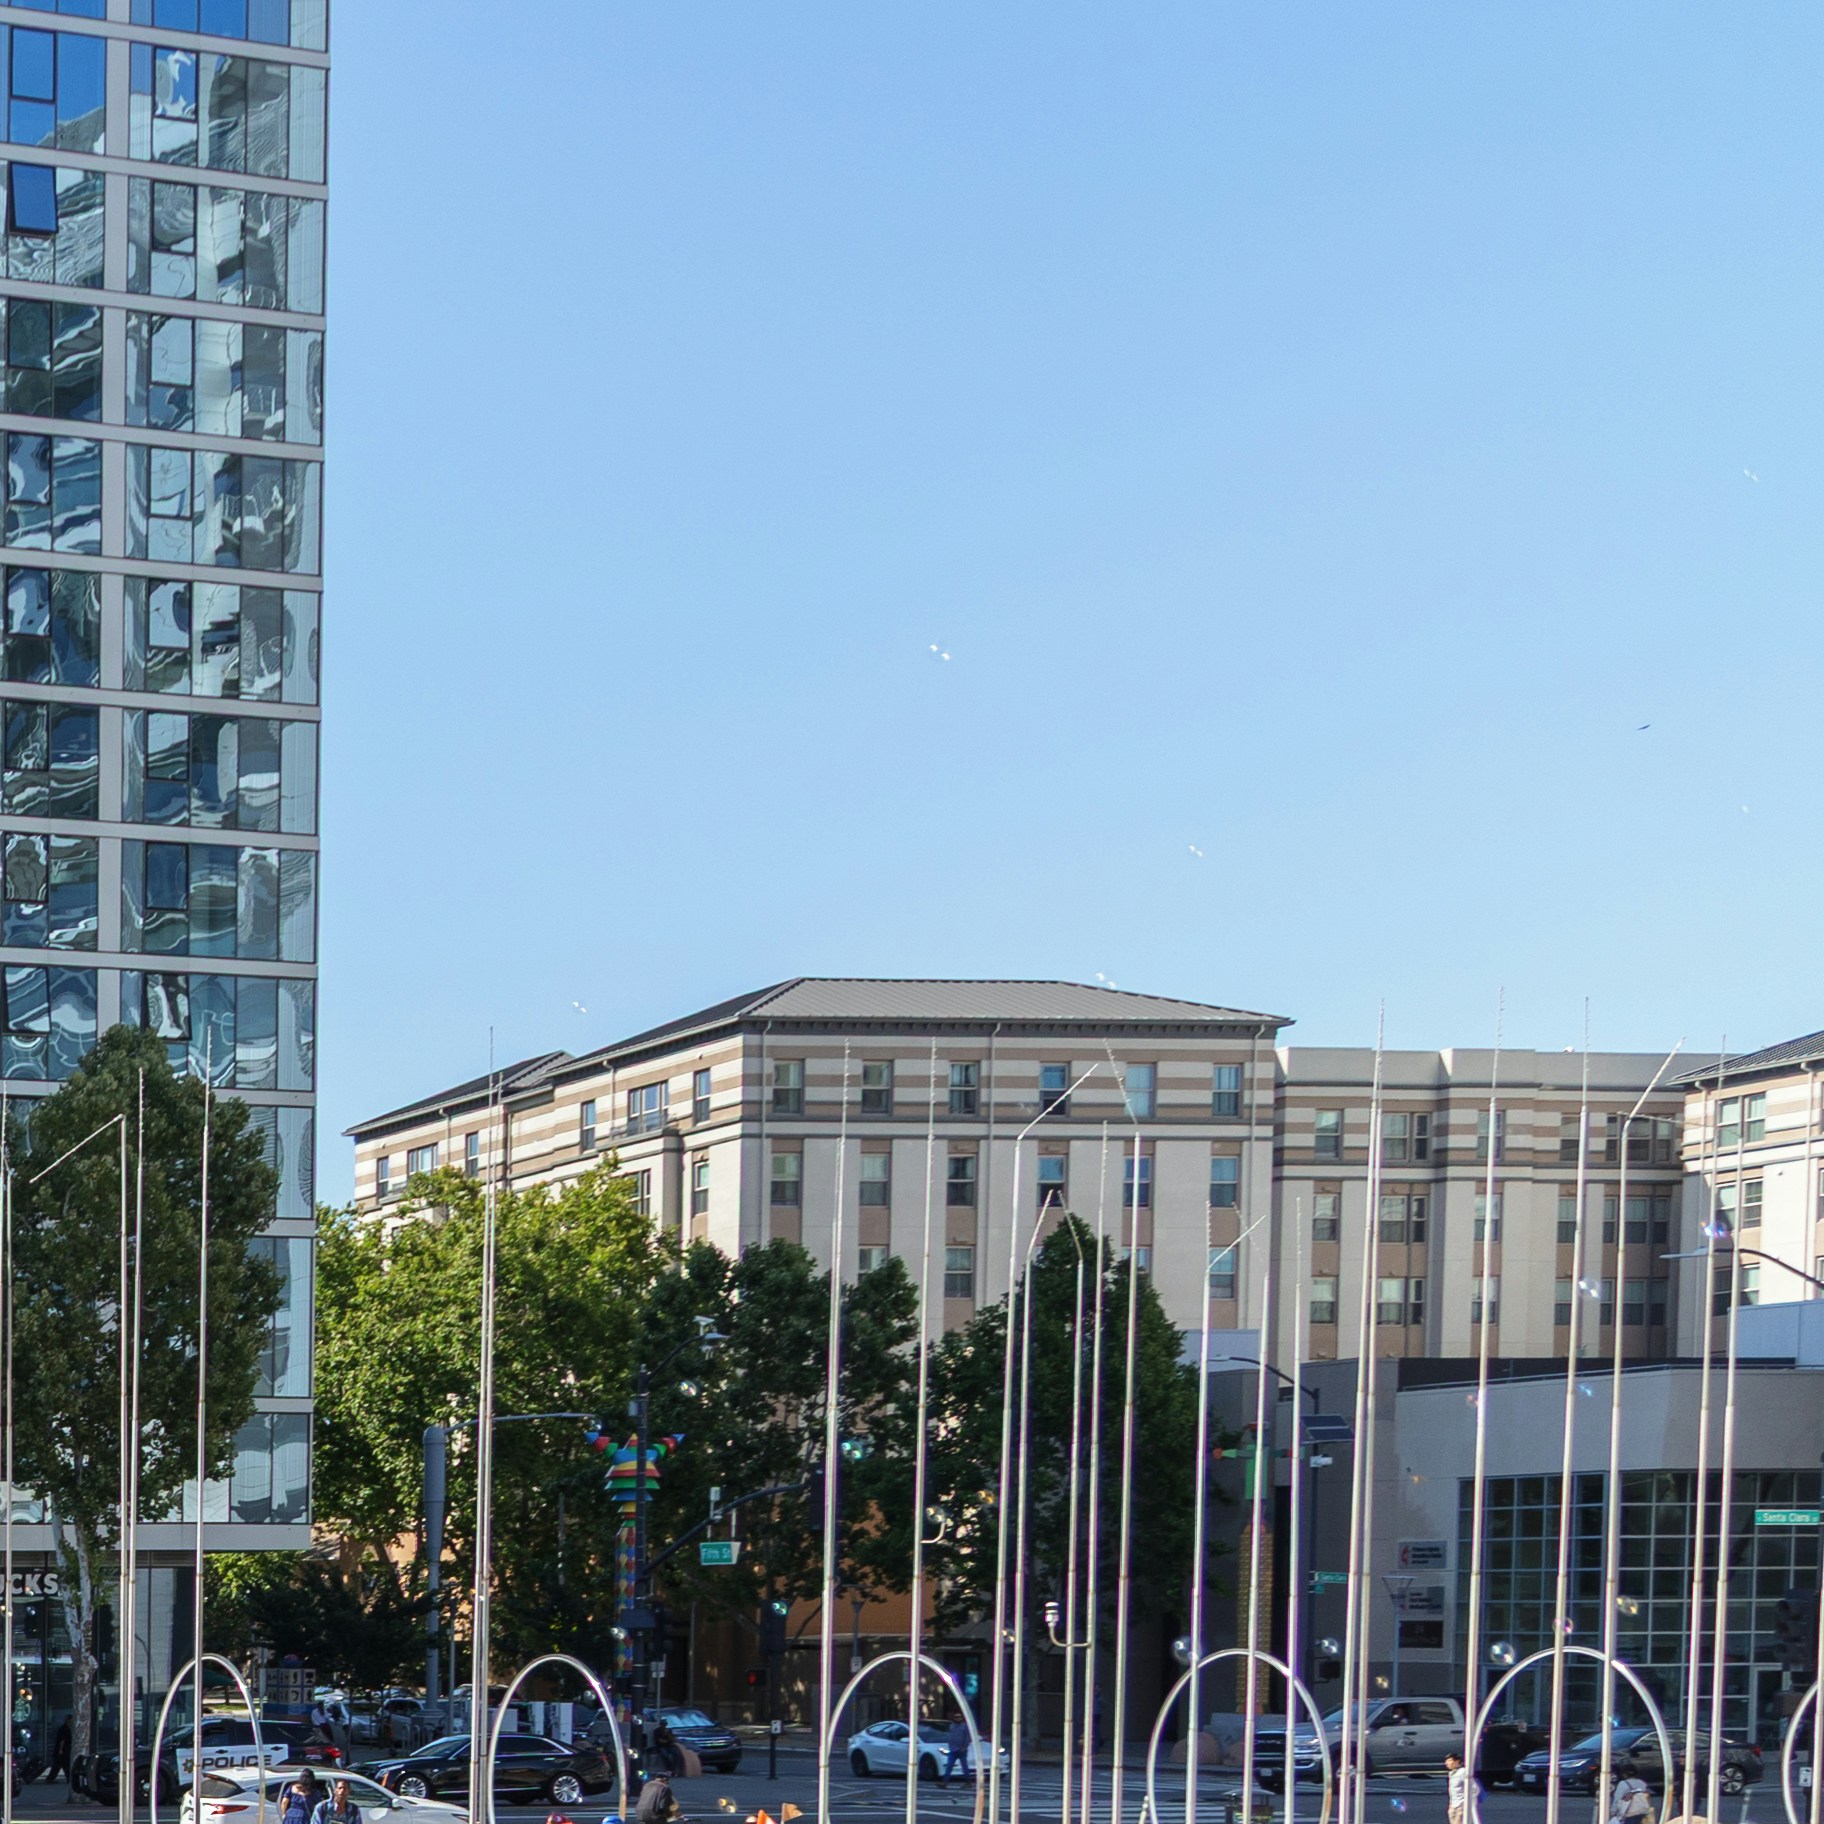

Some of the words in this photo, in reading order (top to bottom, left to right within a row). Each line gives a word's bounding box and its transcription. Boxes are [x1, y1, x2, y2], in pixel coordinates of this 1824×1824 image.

[1763, 1513, 1786, 1522] Santa
[1788, 1513, 1810, 1522] Clara
[202, 1755, 271, 1770] POLICE
